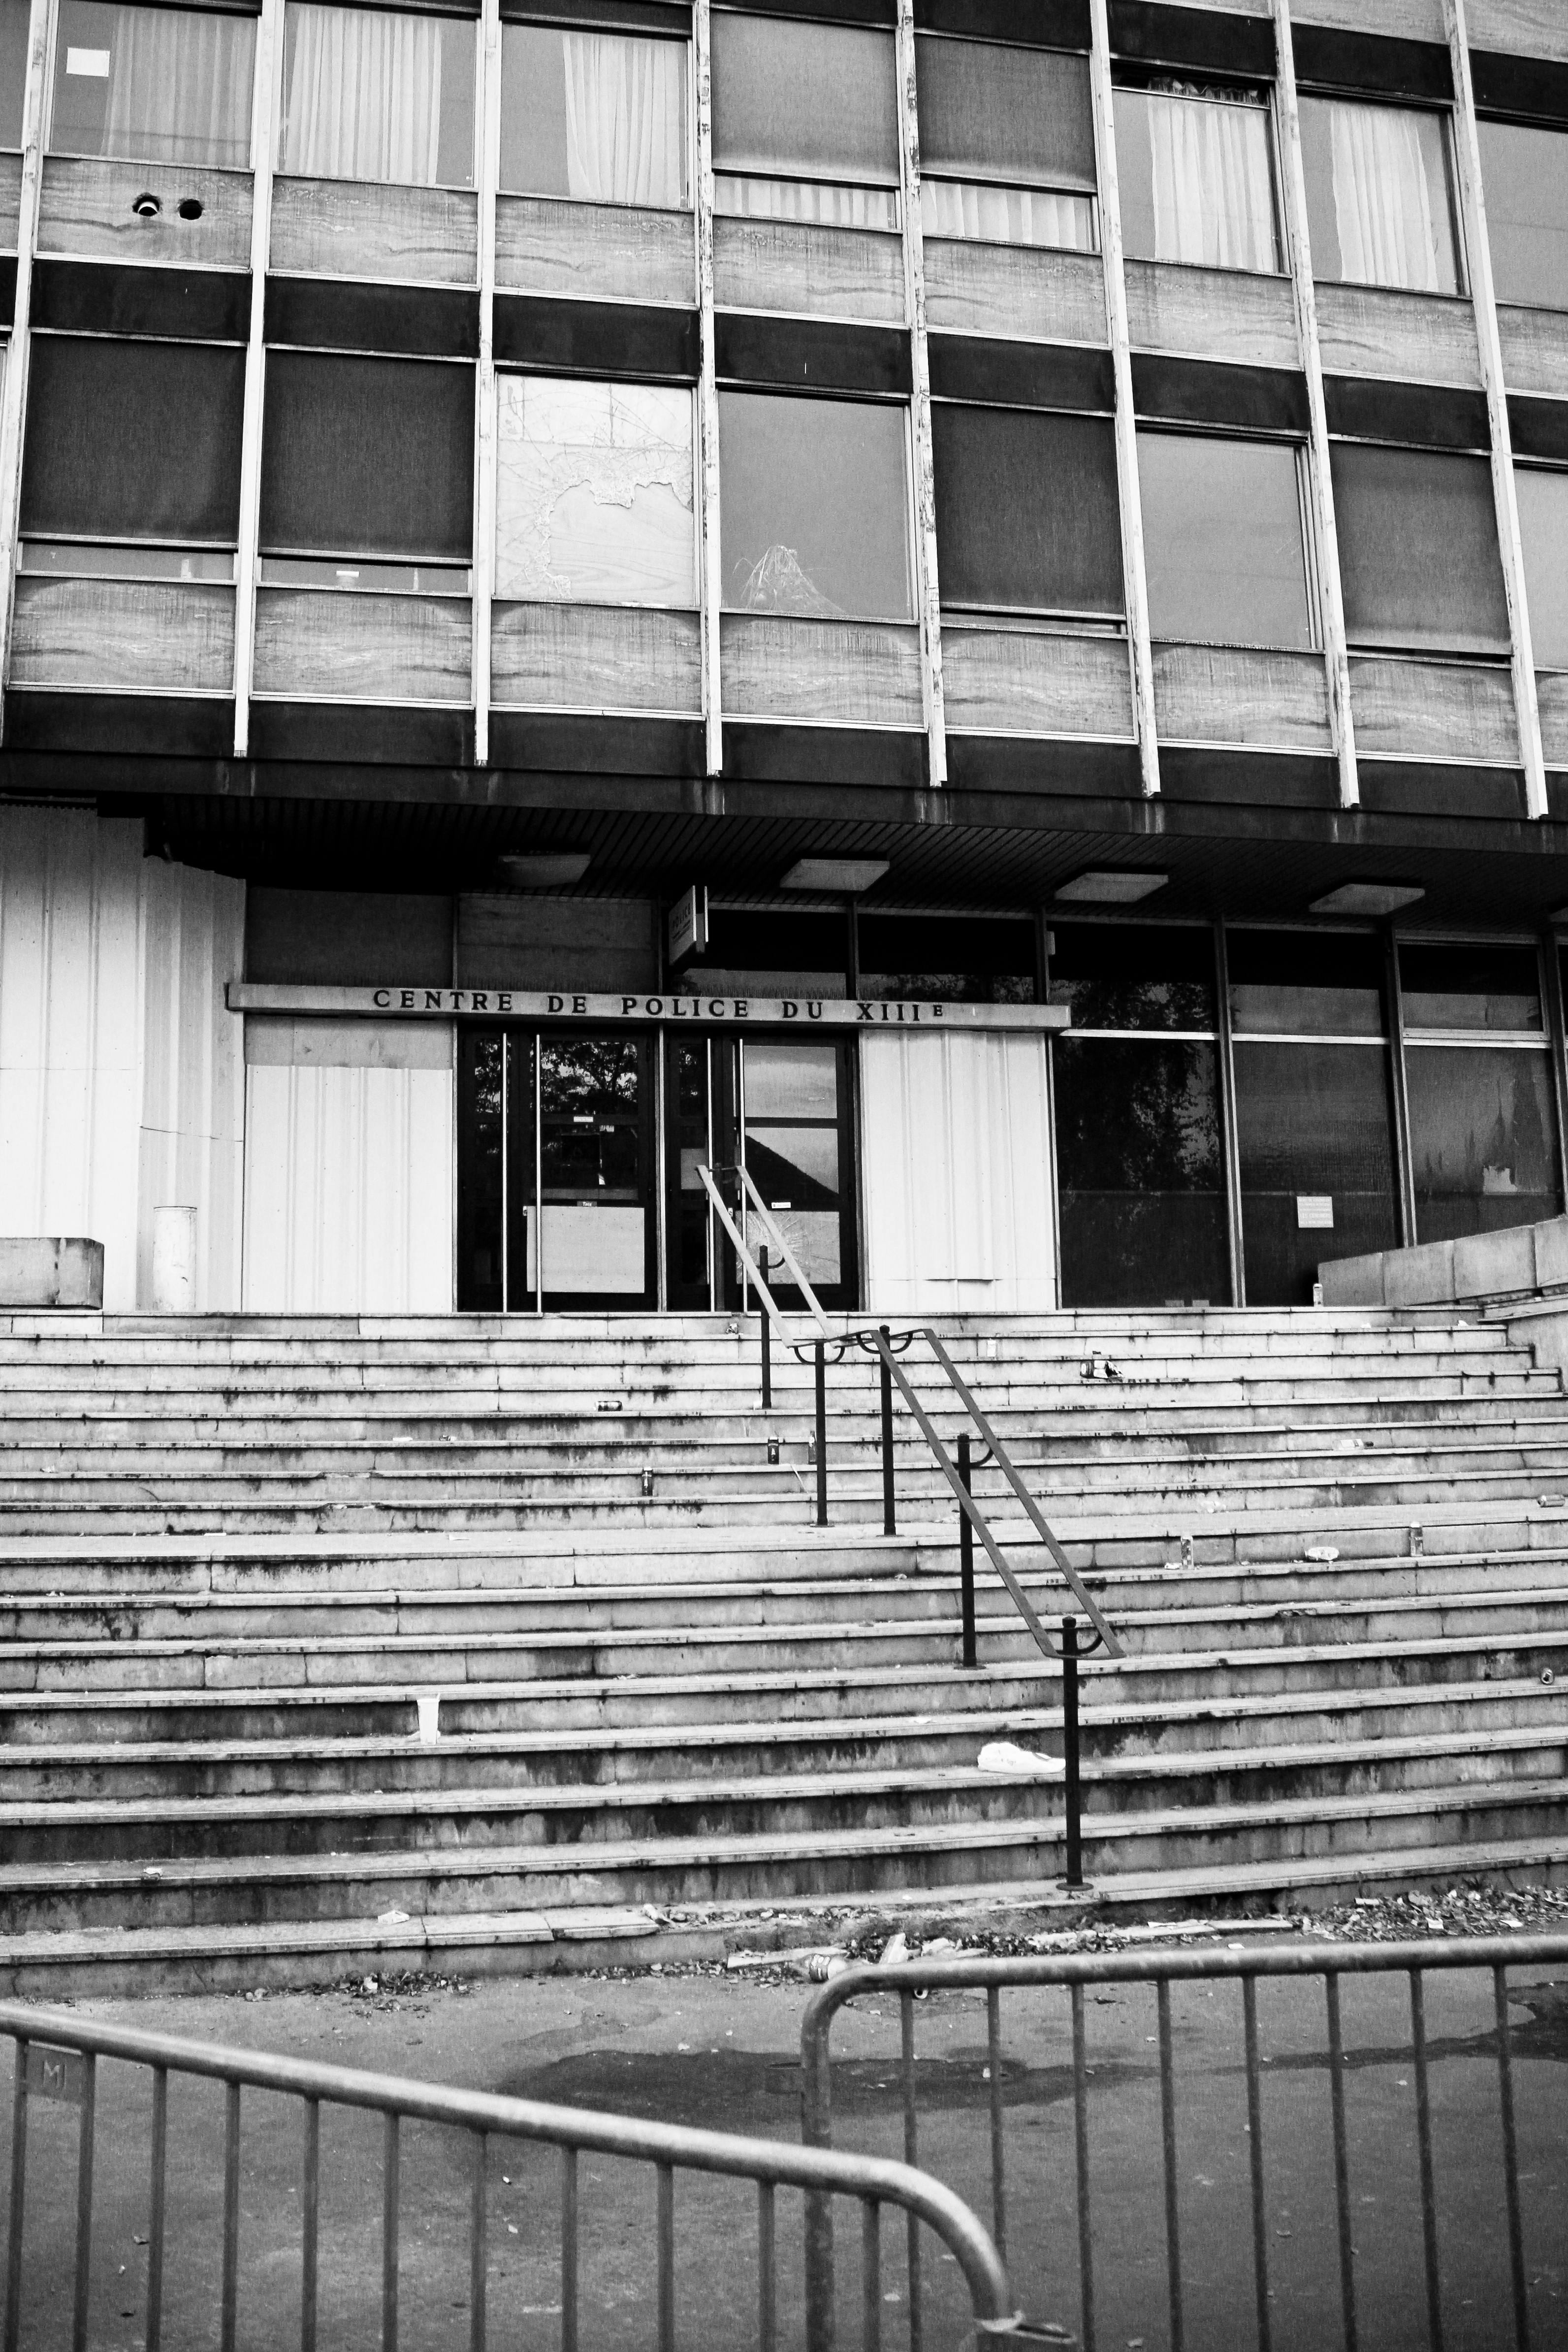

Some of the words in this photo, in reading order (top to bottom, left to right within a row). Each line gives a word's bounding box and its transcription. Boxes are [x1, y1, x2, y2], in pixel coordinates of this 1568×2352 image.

[373, 989, 512, 1011] CENTRE
[547, 995, 586, 1014] DE
[621, 997, 748, 1017] POLICE
[782, 1001, 823, 1019] DU
